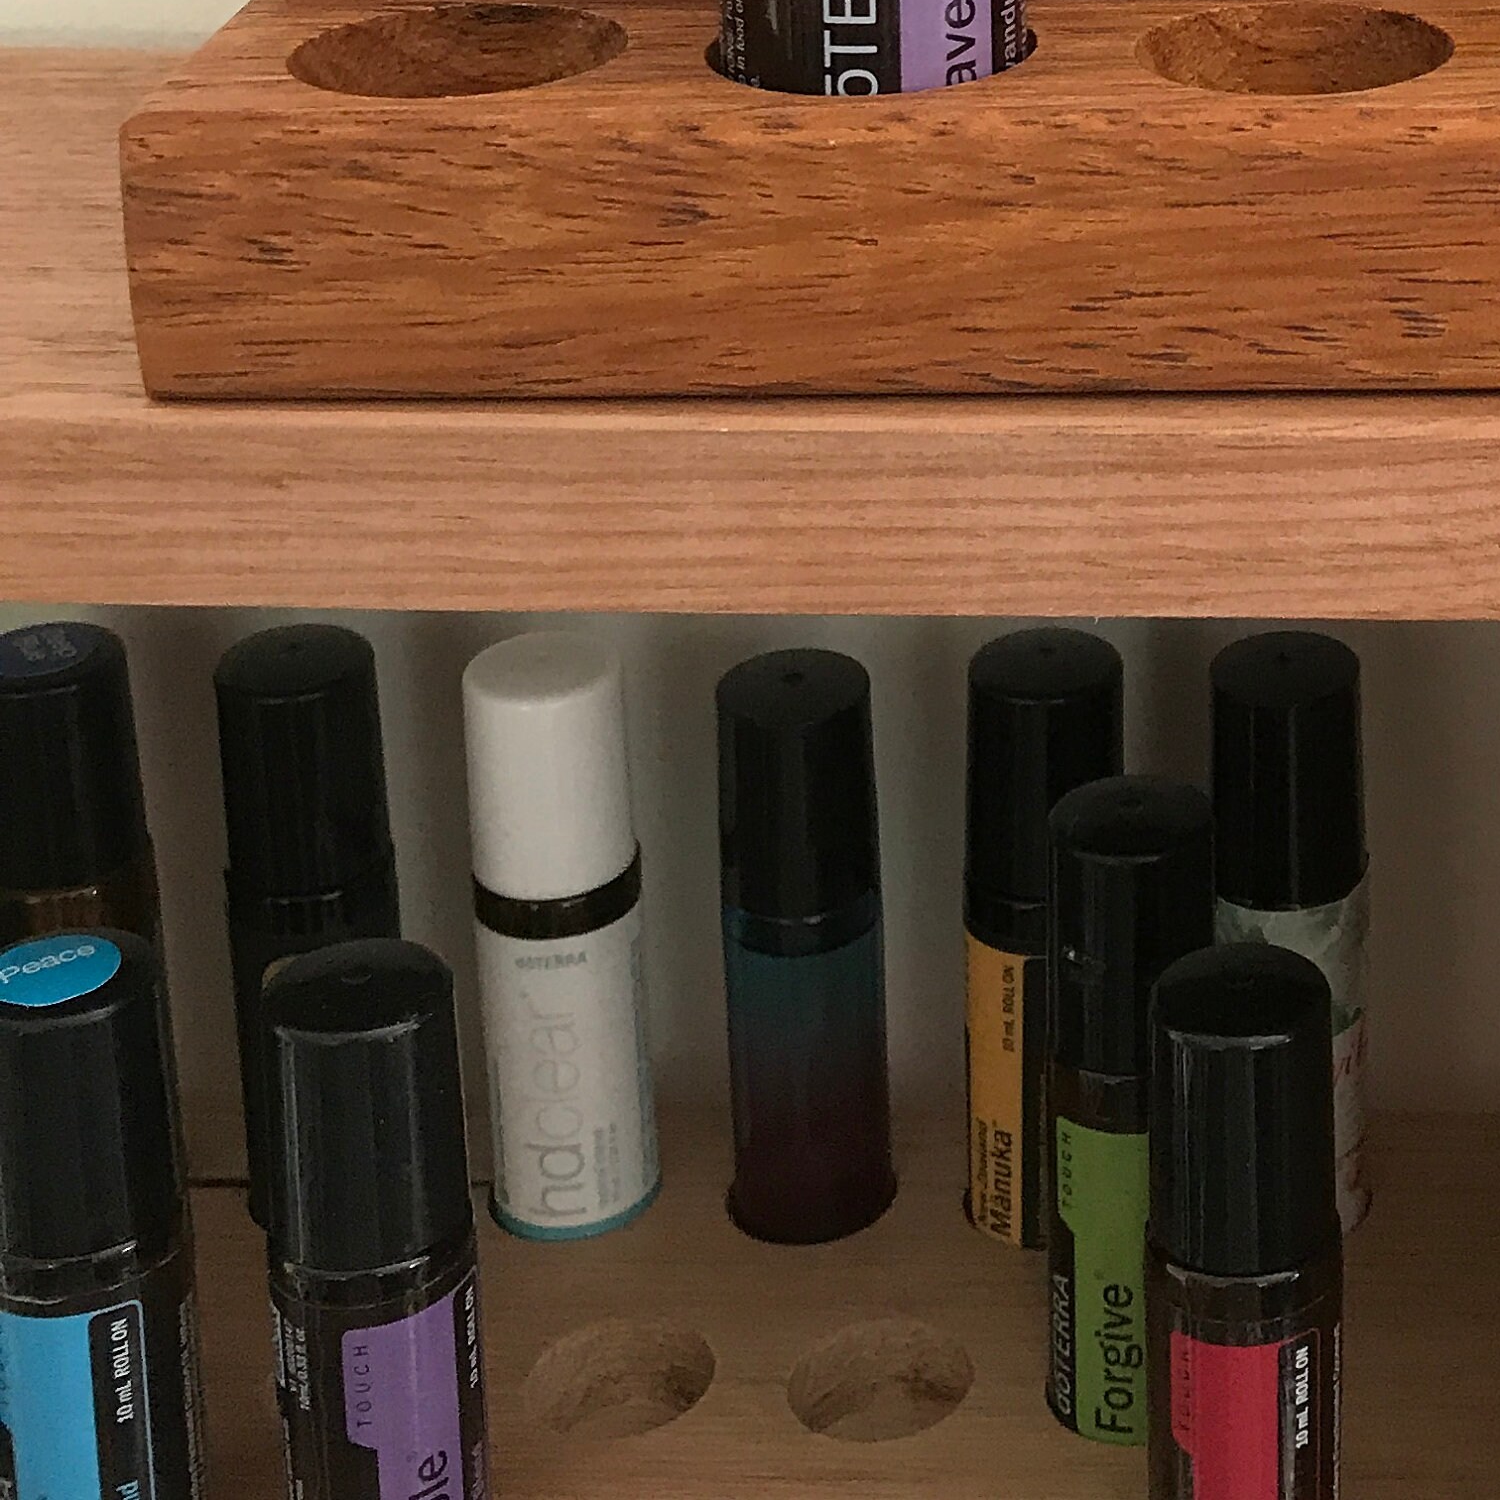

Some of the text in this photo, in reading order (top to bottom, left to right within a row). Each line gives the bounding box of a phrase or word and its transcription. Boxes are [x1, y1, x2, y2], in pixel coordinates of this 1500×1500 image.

[110, 1317, 134, 1424] 10 mL ROLL ON
[352, 1345, 372, 1429] TOUCH
[1094, 1283, 1143, 1435] Forgive
[1295, 1344, 1309, 1449] 10 mL ROLL ON
